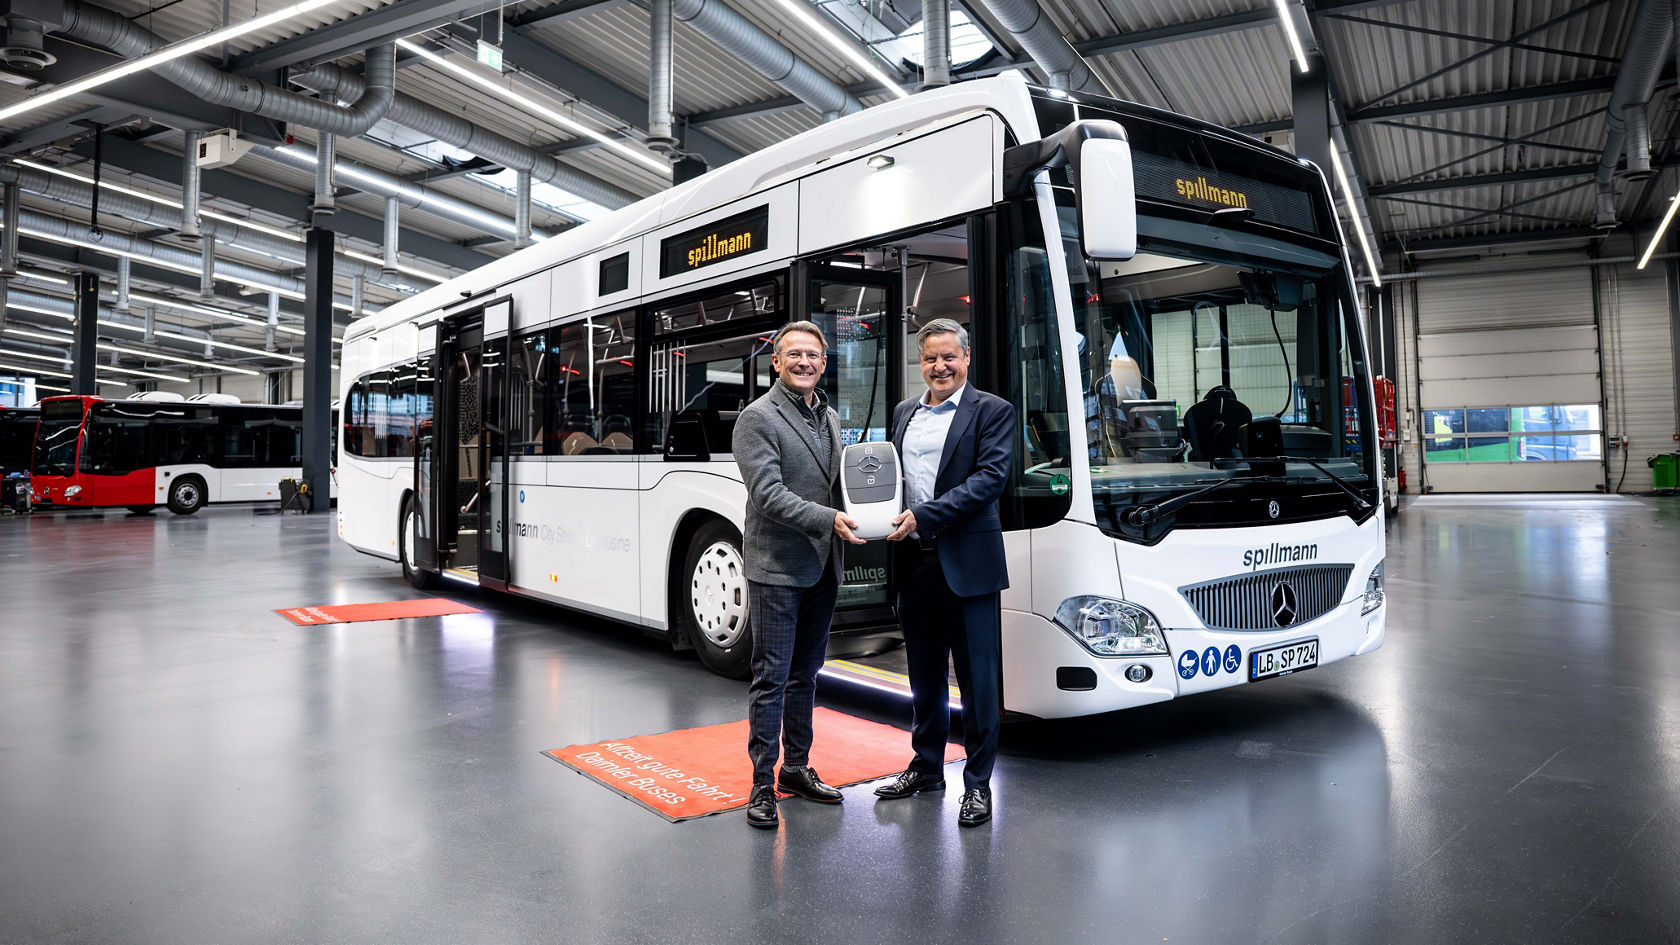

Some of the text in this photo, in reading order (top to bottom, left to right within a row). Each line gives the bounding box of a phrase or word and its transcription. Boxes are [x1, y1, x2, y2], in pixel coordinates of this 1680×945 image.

[1176, 177, 1247, 208] spillmann
[688, 232, 751, 267] spillmann
[1056, 475, 1063, 484] 4
[496, 517, 538, 539] sllmann
[1243, 542, 1318, 571] spillmann
[1259, 643, 1315, 674] LB SP 724
[576, 751, 686, 804] Daimler Buses
[600, 742, 653, 764] Allzeit
[637, 759, 685, 780] gute
[677, 777, 733, 800] Fahrt
